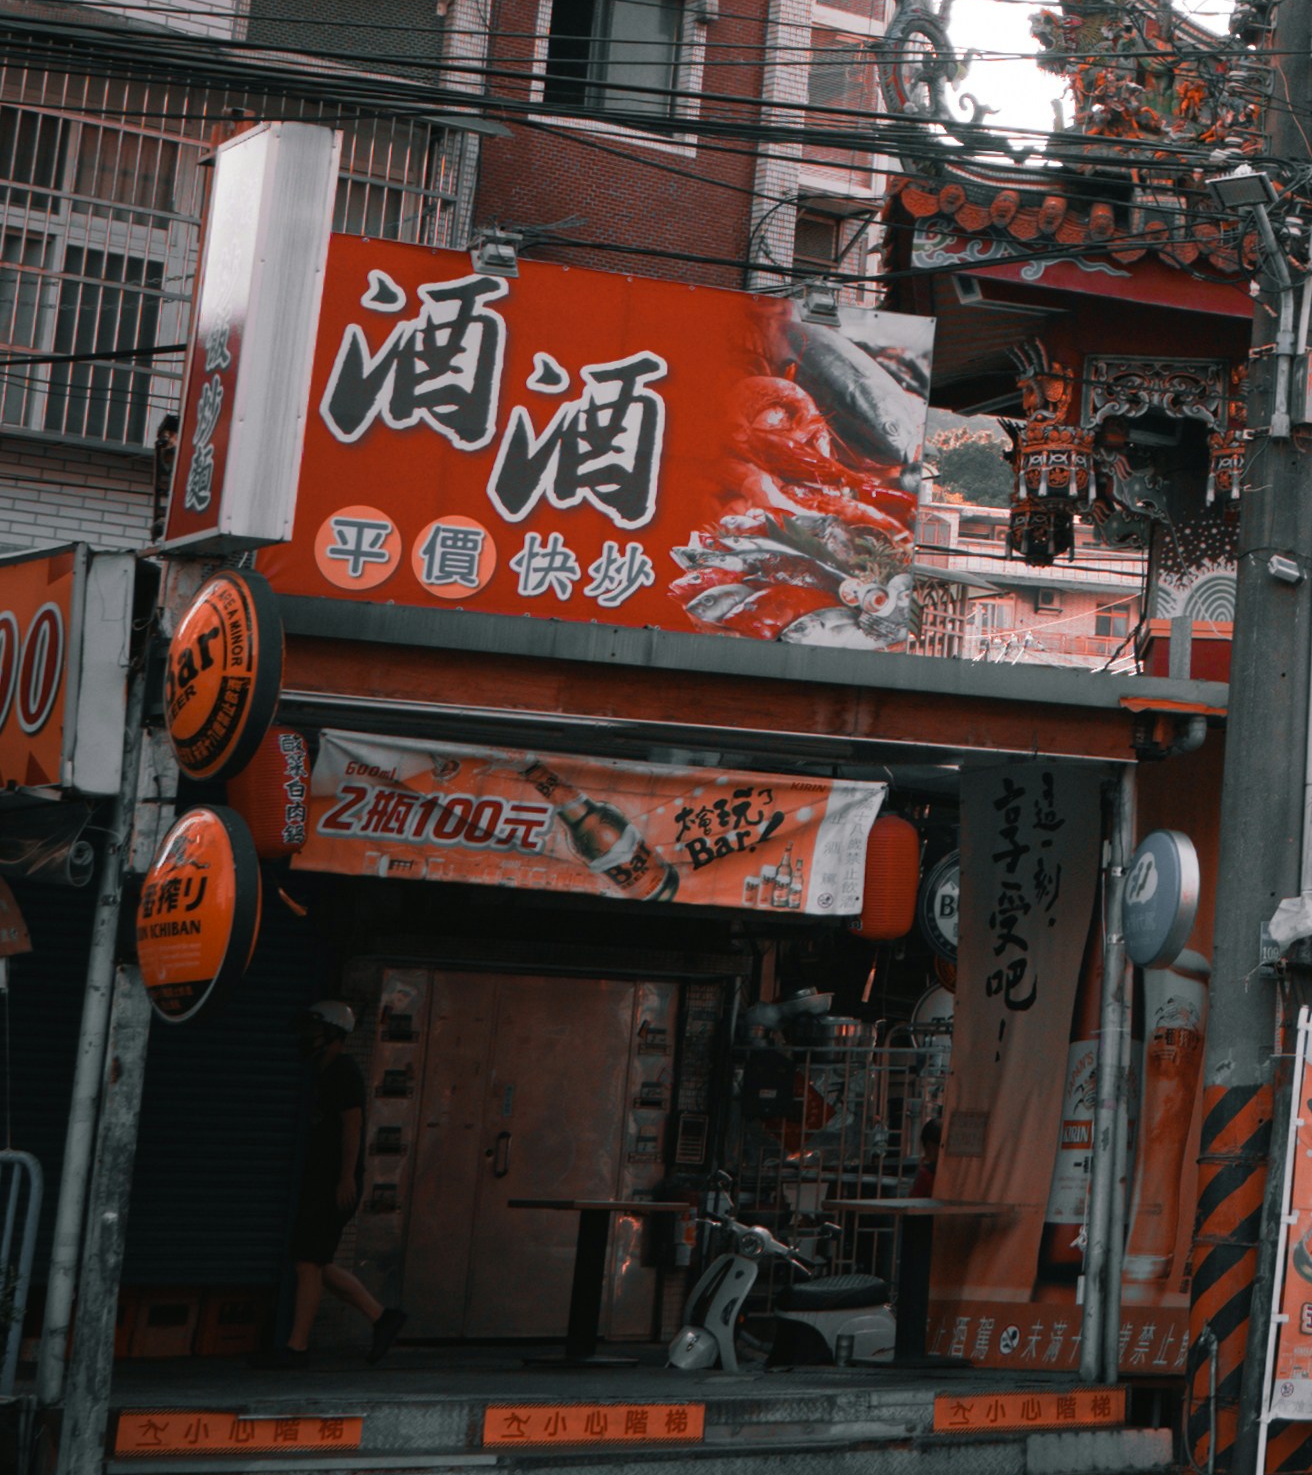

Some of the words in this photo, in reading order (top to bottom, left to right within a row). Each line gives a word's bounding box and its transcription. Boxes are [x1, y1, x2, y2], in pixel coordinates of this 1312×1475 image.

[319, 269, 668, 530] 酒酒
[326, 515, 655, 607] 平價快炒
[230, 621, 243, 667] MINOR
[789, 780, 828, 793] KIRIN
[319, 782, 552, 854] 2瓶100元
[150, 919, 202, 939] ICHIBAN
[1062, 1124, 1090, 1144] KIRIN
[926, 1315, 995, 1362] 止酒駕
[542, 1409, 690, 1438] 小心階梯
[985, 1395, 1112, 1424] 小心階梯
